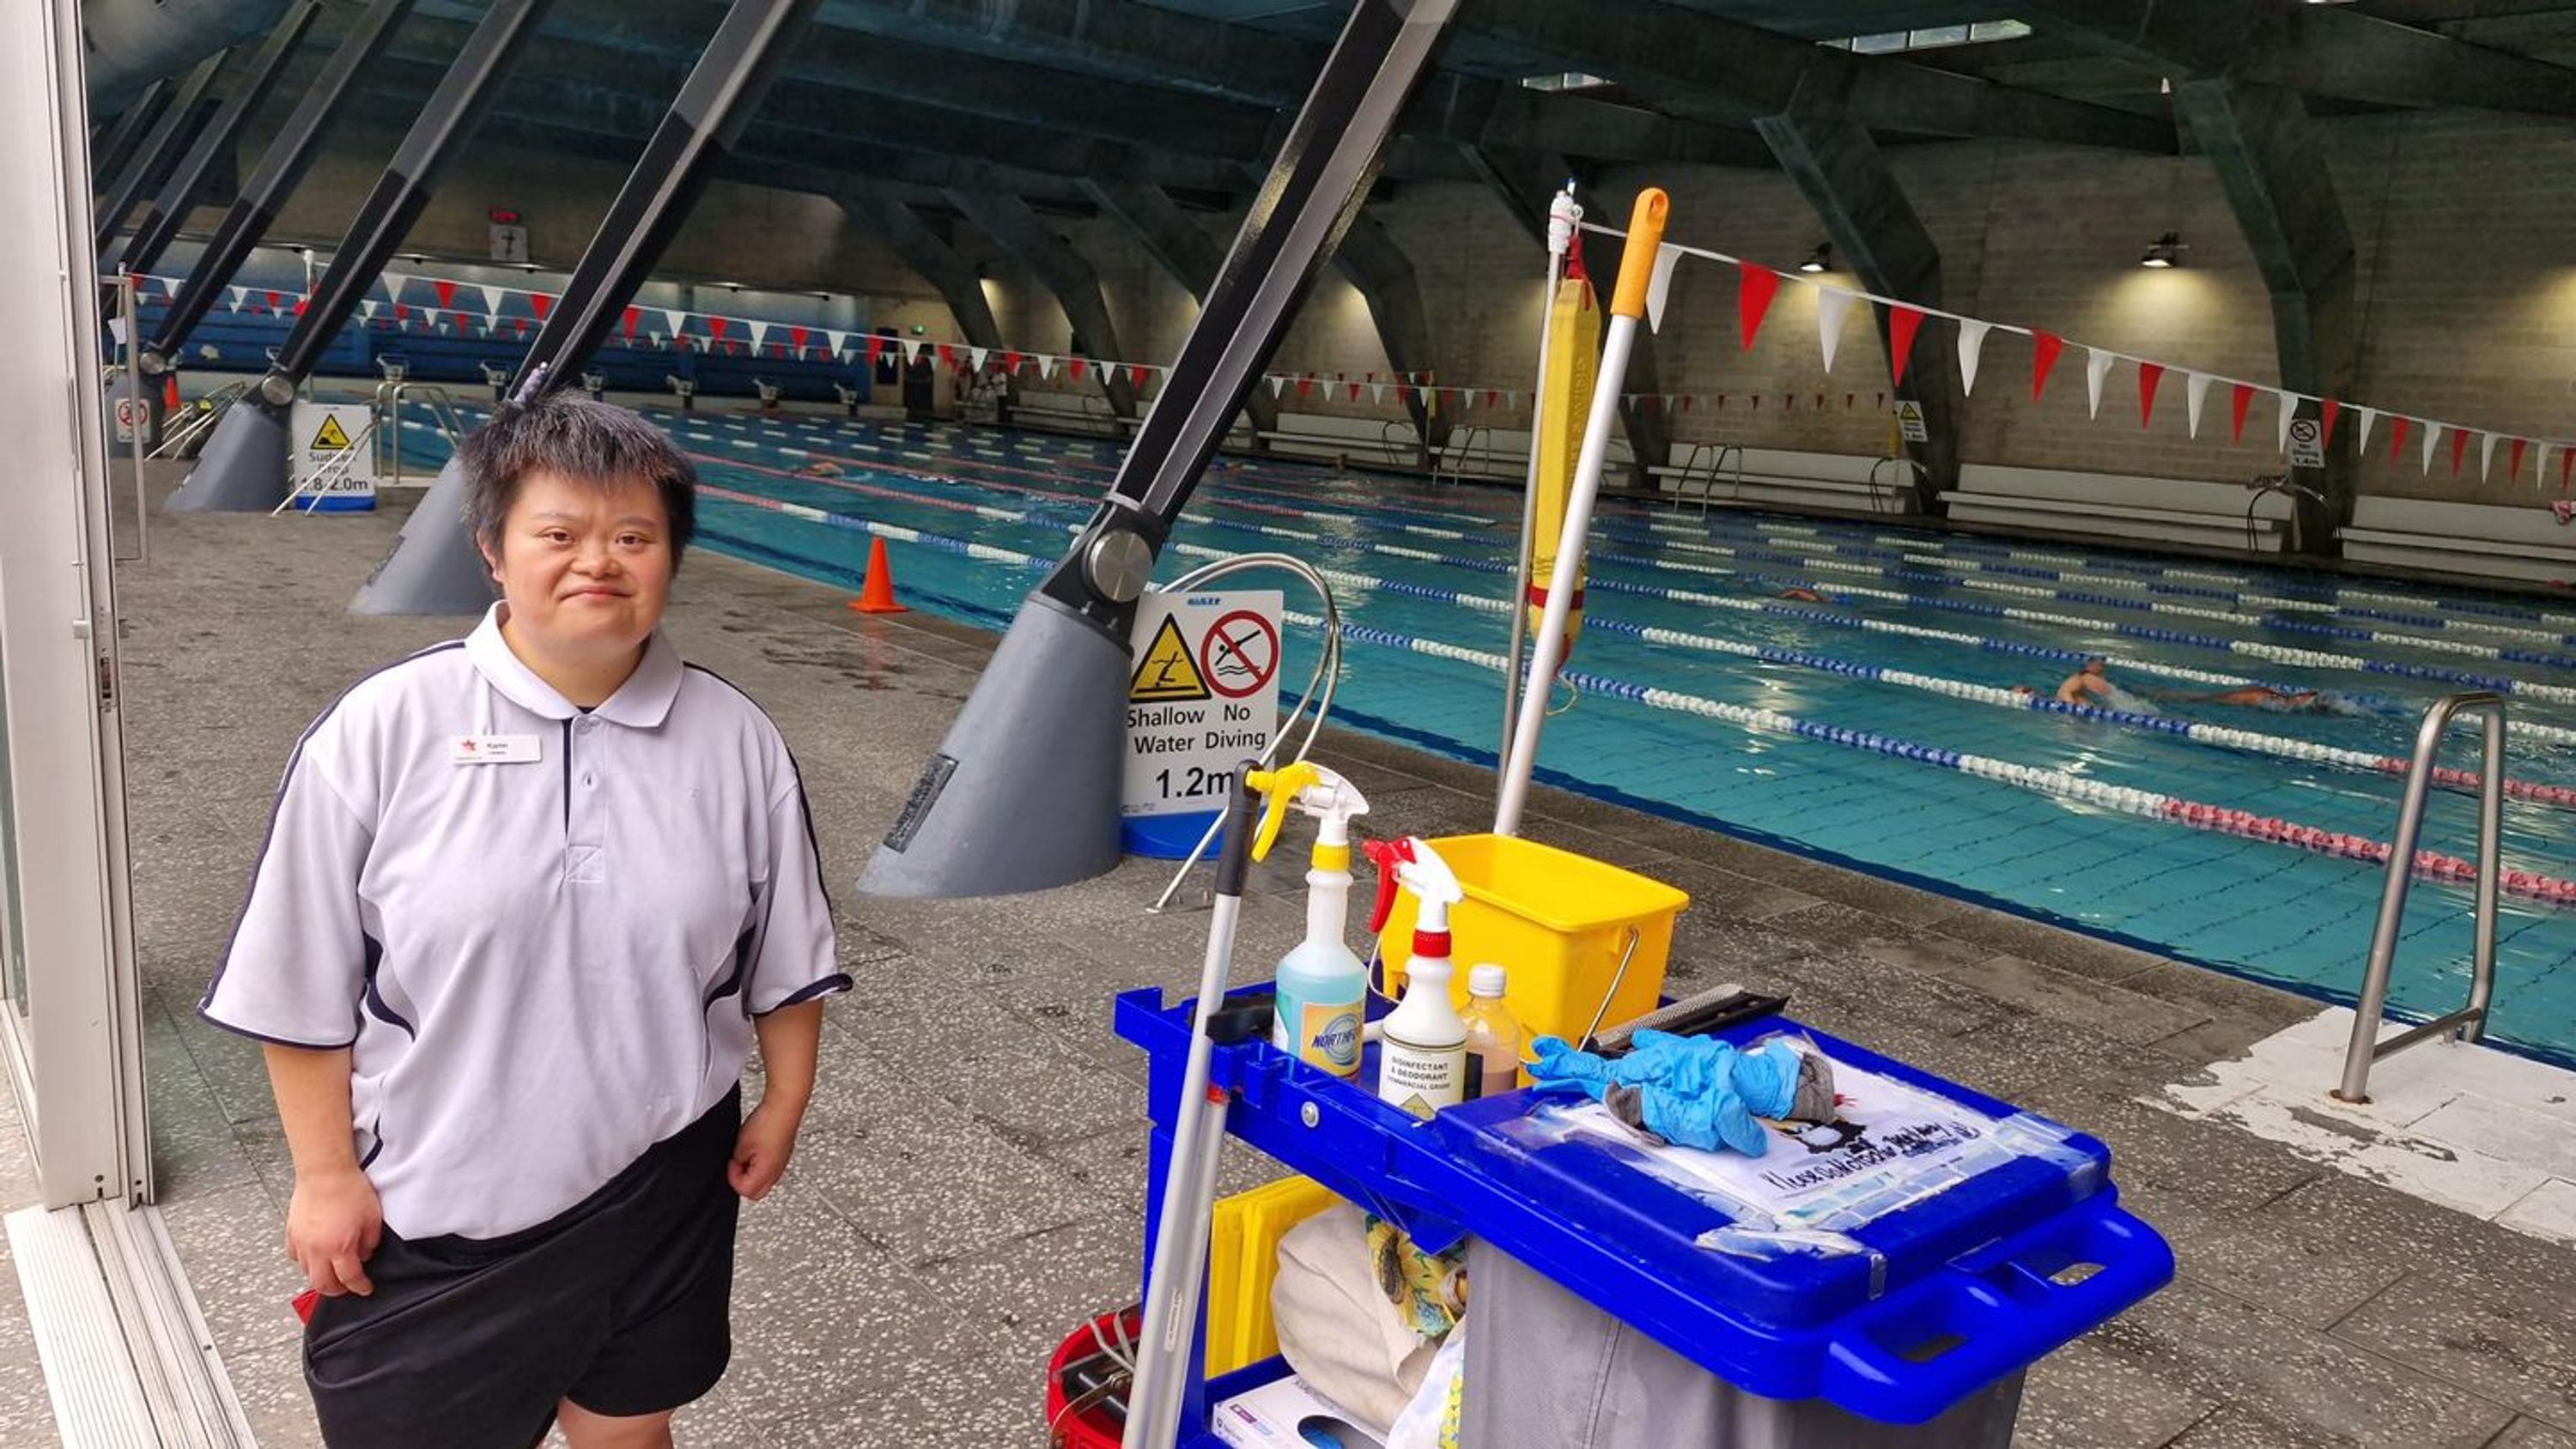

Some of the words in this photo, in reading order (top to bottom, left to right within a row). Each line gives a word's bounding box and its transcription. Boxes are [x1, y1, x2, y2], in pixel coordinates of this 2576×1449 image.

[1127, 706, 1205, 727] Shallow
[1224, 704, 1250, 721] No
[1134, 737, 1194, 754] Water
[1206, 730, 1266, 750] Diving
[1157, 767, 1234, 798] 1.2m
